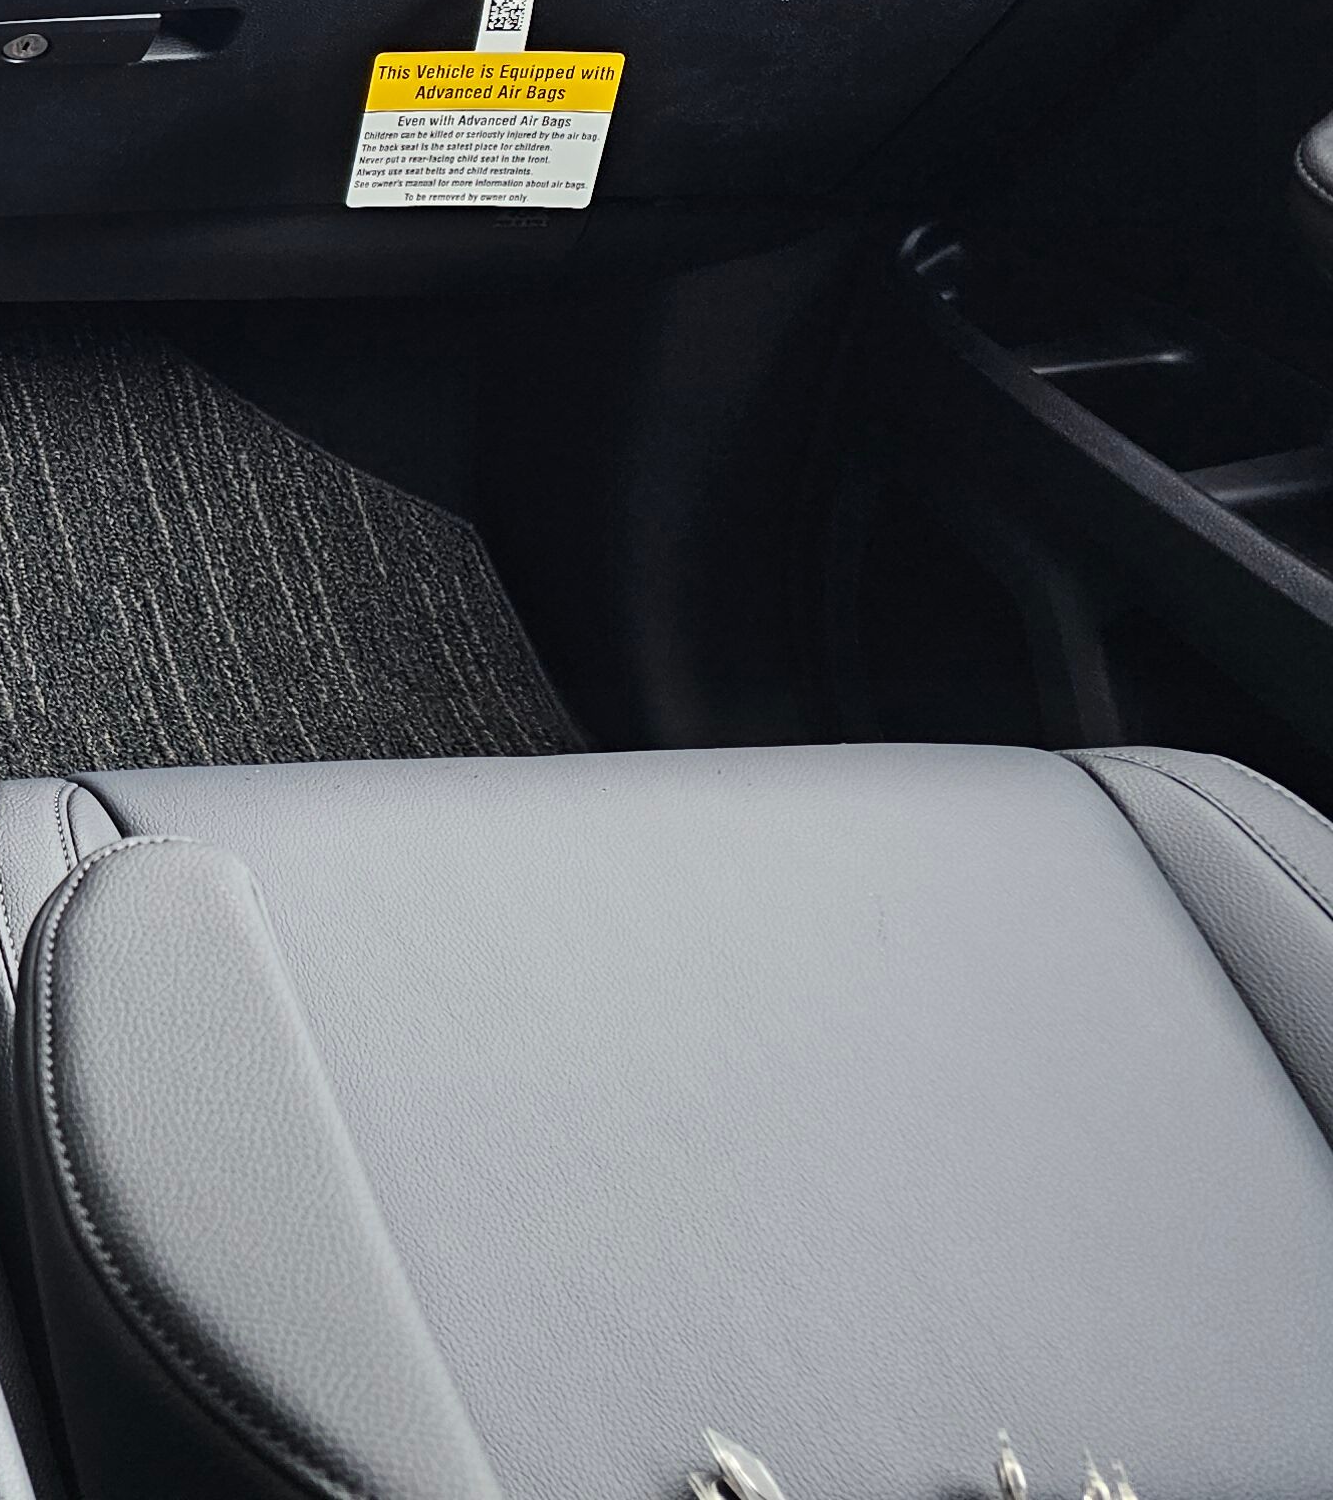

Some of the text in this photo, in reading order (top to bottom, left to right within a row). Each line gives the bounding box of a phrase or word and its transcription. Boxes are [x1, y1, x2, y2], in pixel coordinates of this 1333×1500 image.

[378, 64, 615, 82] This Vehicle is Equipped with
[415, 85, 566, 102] Advanced Air Bags
[398, 115, 572, 129] Even with Advanced Air Bags
[364, 131, 398, 140] Children
[417, 131, 428, 139] be
[430, 130, 453, 138] killed
[466, 130, 505, 140] seriously
[507, 130, 537, 140] injured
[539, 131, 550, 140] by
[552, 131, 565, 139] the
[567, 132, 580, 140] air
[581, 133, 600, 142] bag.
[362, 142, 553, 152] The back seat the safest place for children.
[359, 154, 550, 165] Never put rear-facing child seat the front.
[356, 167, 533, 178] Always seat belts and child restraints.
[353, 180, 370, 188] See
[371, 179, 403, 188] owner's
[405, 179, 436, 187] manual
[437, 179, 450, 187] for
[475, 179, 524, 187] information
[525, 180, 549, 188] about
[565, 181, 588, 190] bags.
[416, 193, 426, 201] be
[428, 193, 466, 201] removed
[467, 193, 478, 203] by
[509, 193, 529, 203] only.
